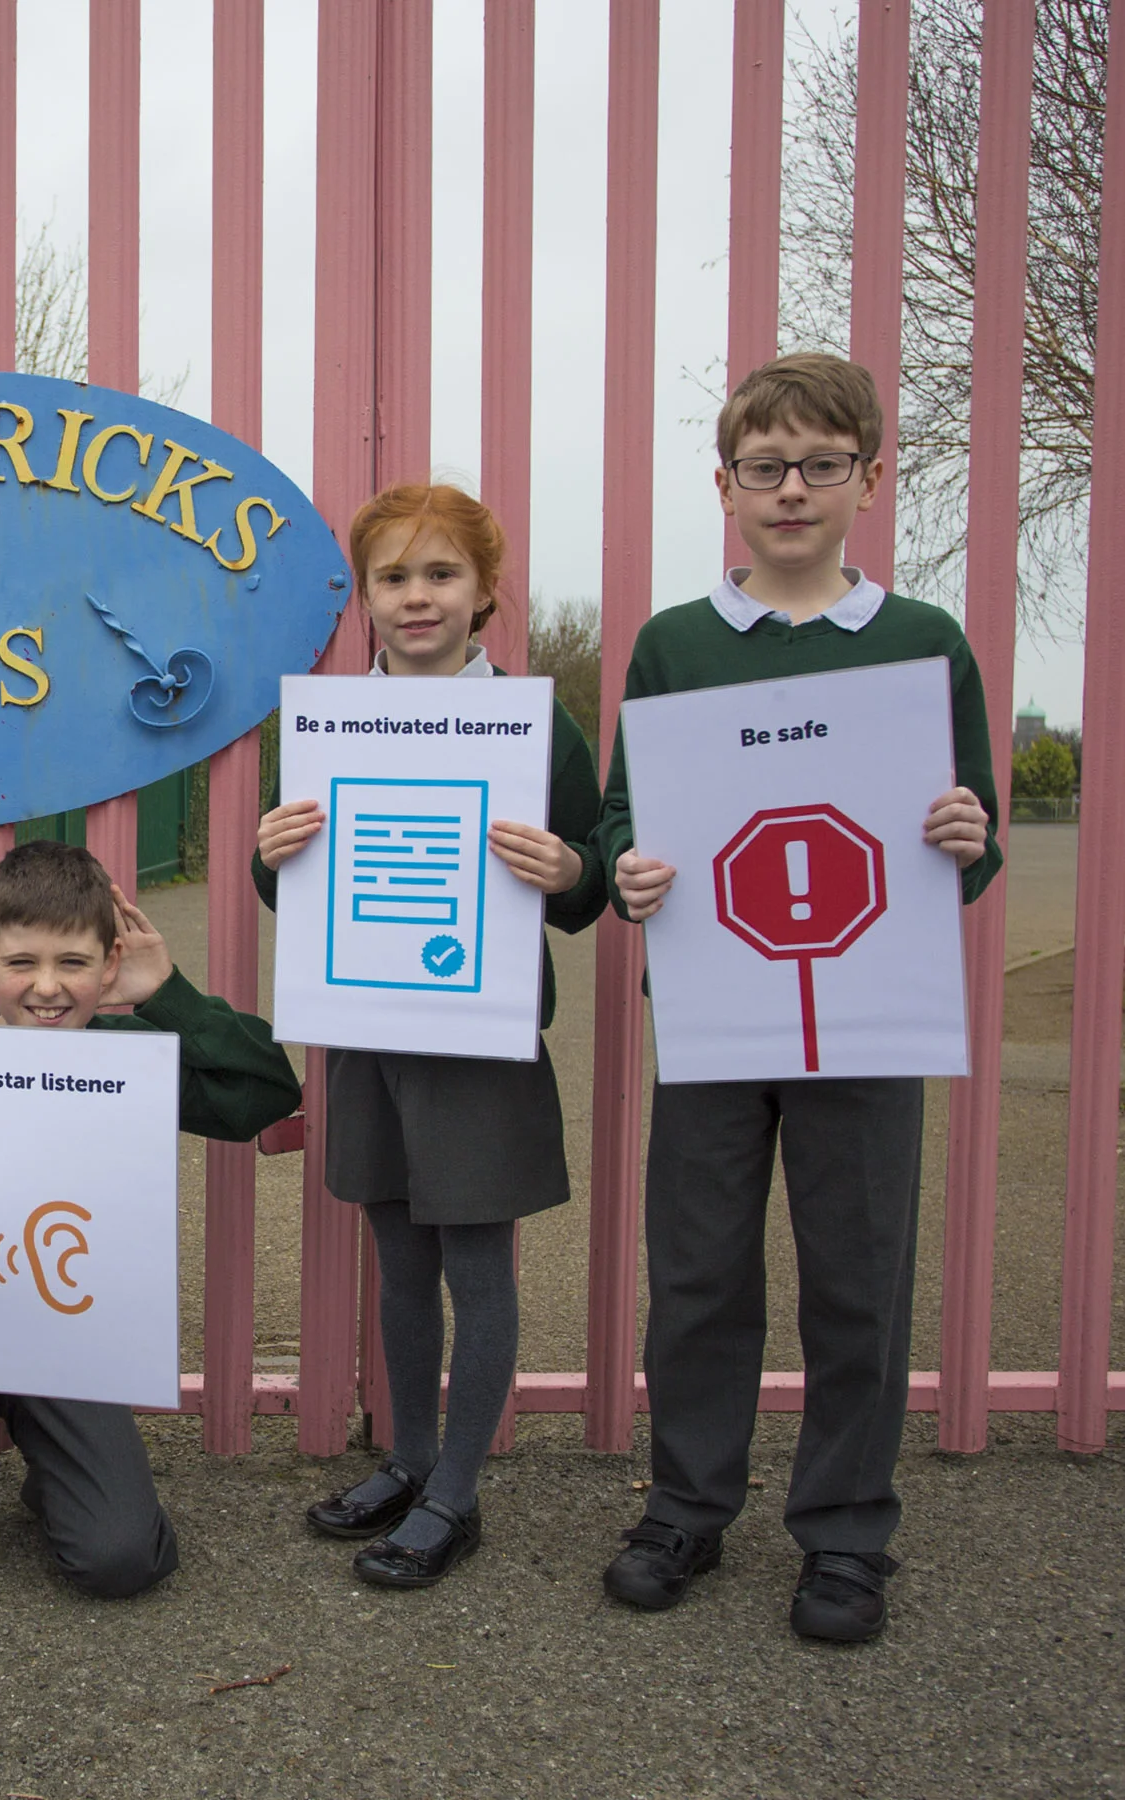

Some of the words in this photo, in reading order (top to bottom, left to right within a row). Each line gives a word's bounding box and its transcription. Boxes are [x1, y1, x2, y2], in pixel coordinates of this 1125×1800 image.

[0, 627, 50, 707] S
[295, 715, 320, 733] Be
[324, 719, 336, 733] a
[341, 716, 449, 736] motivated
[455, 717, 533, 736] learner
[739, 727, 772, 748] Be
[776, 719, 829, 743] safe
[41, 1072, 126, 1094] listener
